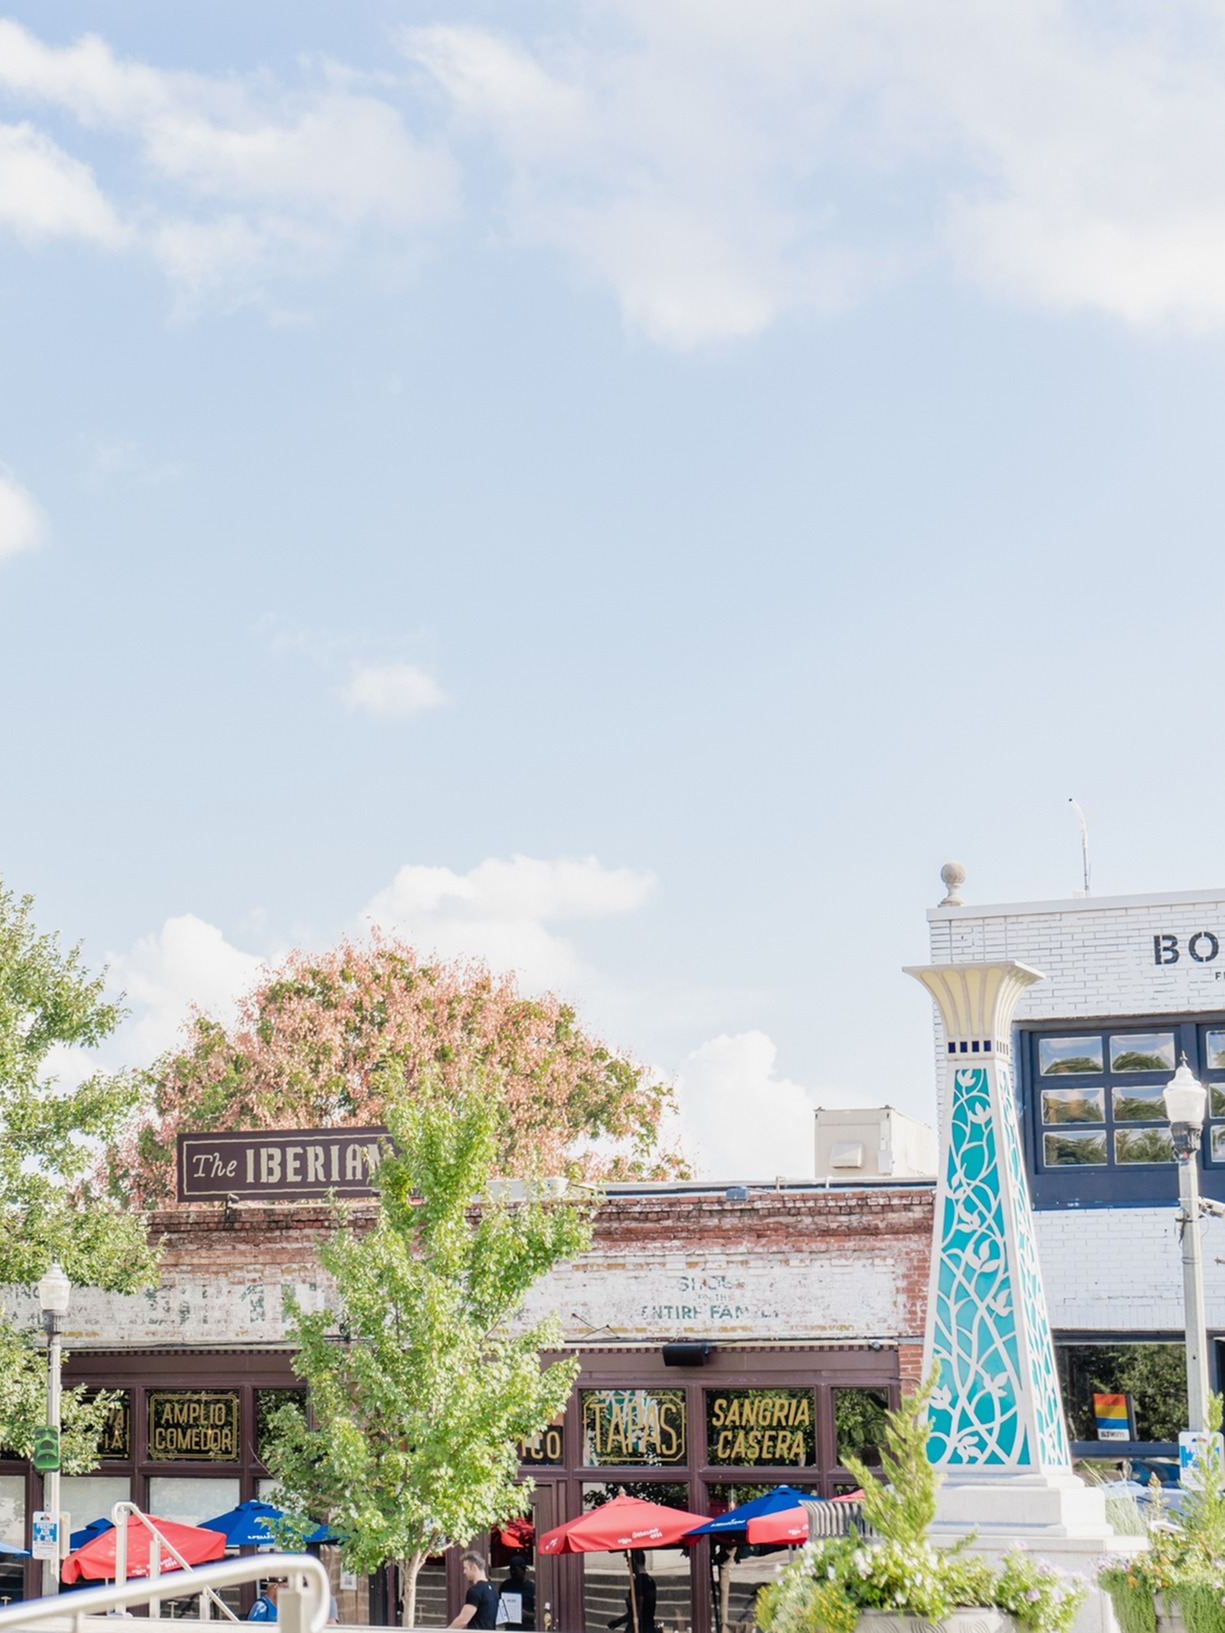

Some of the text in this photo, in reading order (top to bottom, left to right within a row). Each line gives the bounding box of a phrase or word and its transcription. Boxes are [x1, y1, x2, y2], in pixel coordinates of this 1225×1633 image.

[192, 1153, 237, 1178] The
[162, 1403, 226, 1426] AMPLIO
[712, 1398, 810, 1427] SANGRIA
[155, 1427, 232, 1451] COMEDOR
[588, 1403, 677, 1455] TAPAS
[717, 1430, 805, 1460] CASERA
